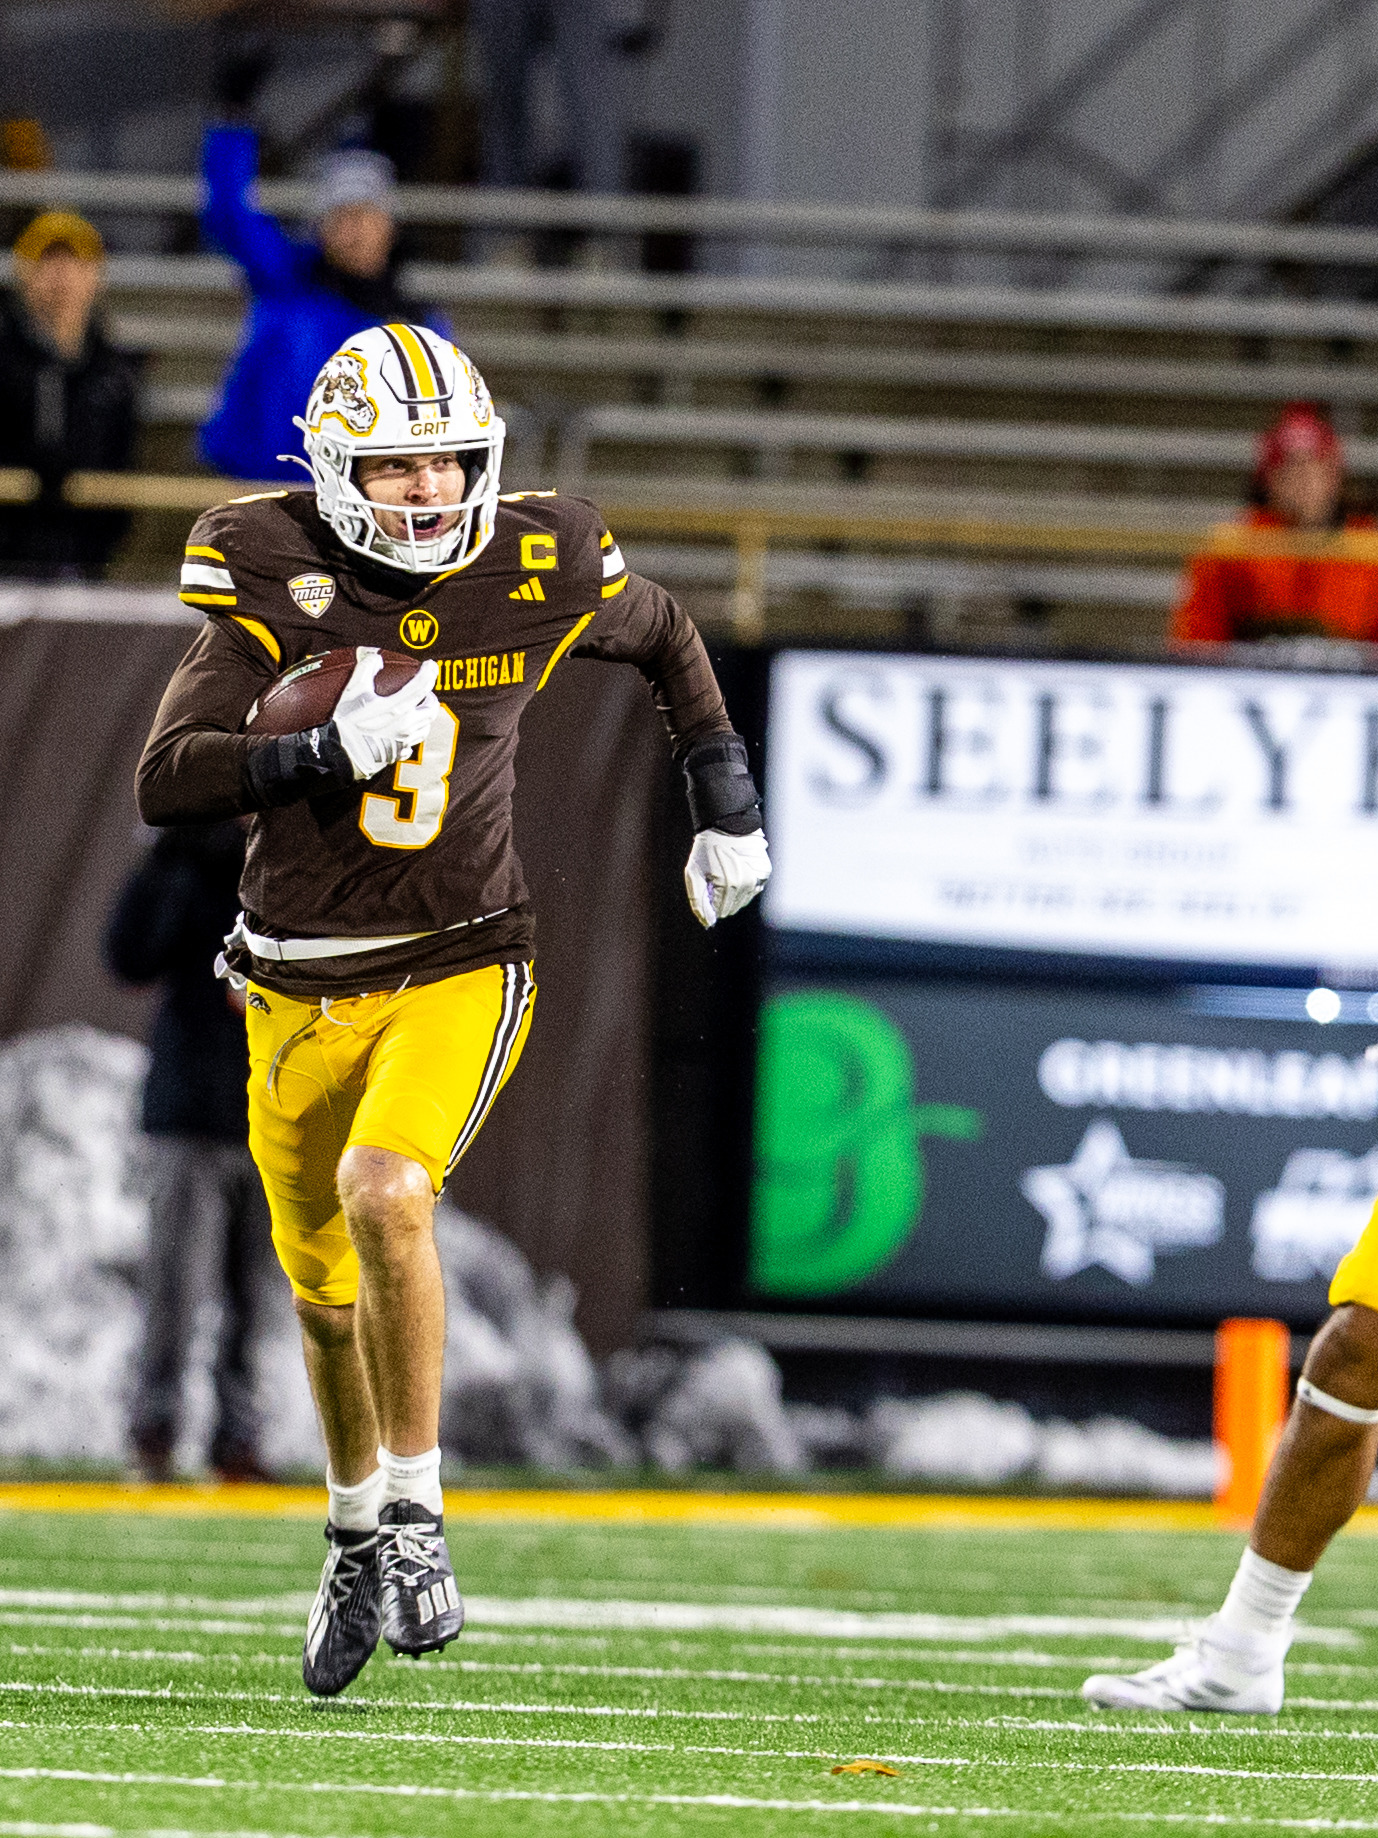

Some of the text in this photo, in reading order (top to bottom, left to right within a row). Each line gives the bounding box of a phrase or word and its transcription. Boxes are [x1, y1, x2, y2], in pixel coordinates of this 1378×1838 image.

[410, 421, 450, 437] GRIT
[520, 534, 557, 569] C
[294, 586, 333, 601] MAC
[407, 619, 432, 642] W
[358, 702, 461, 850] 3
